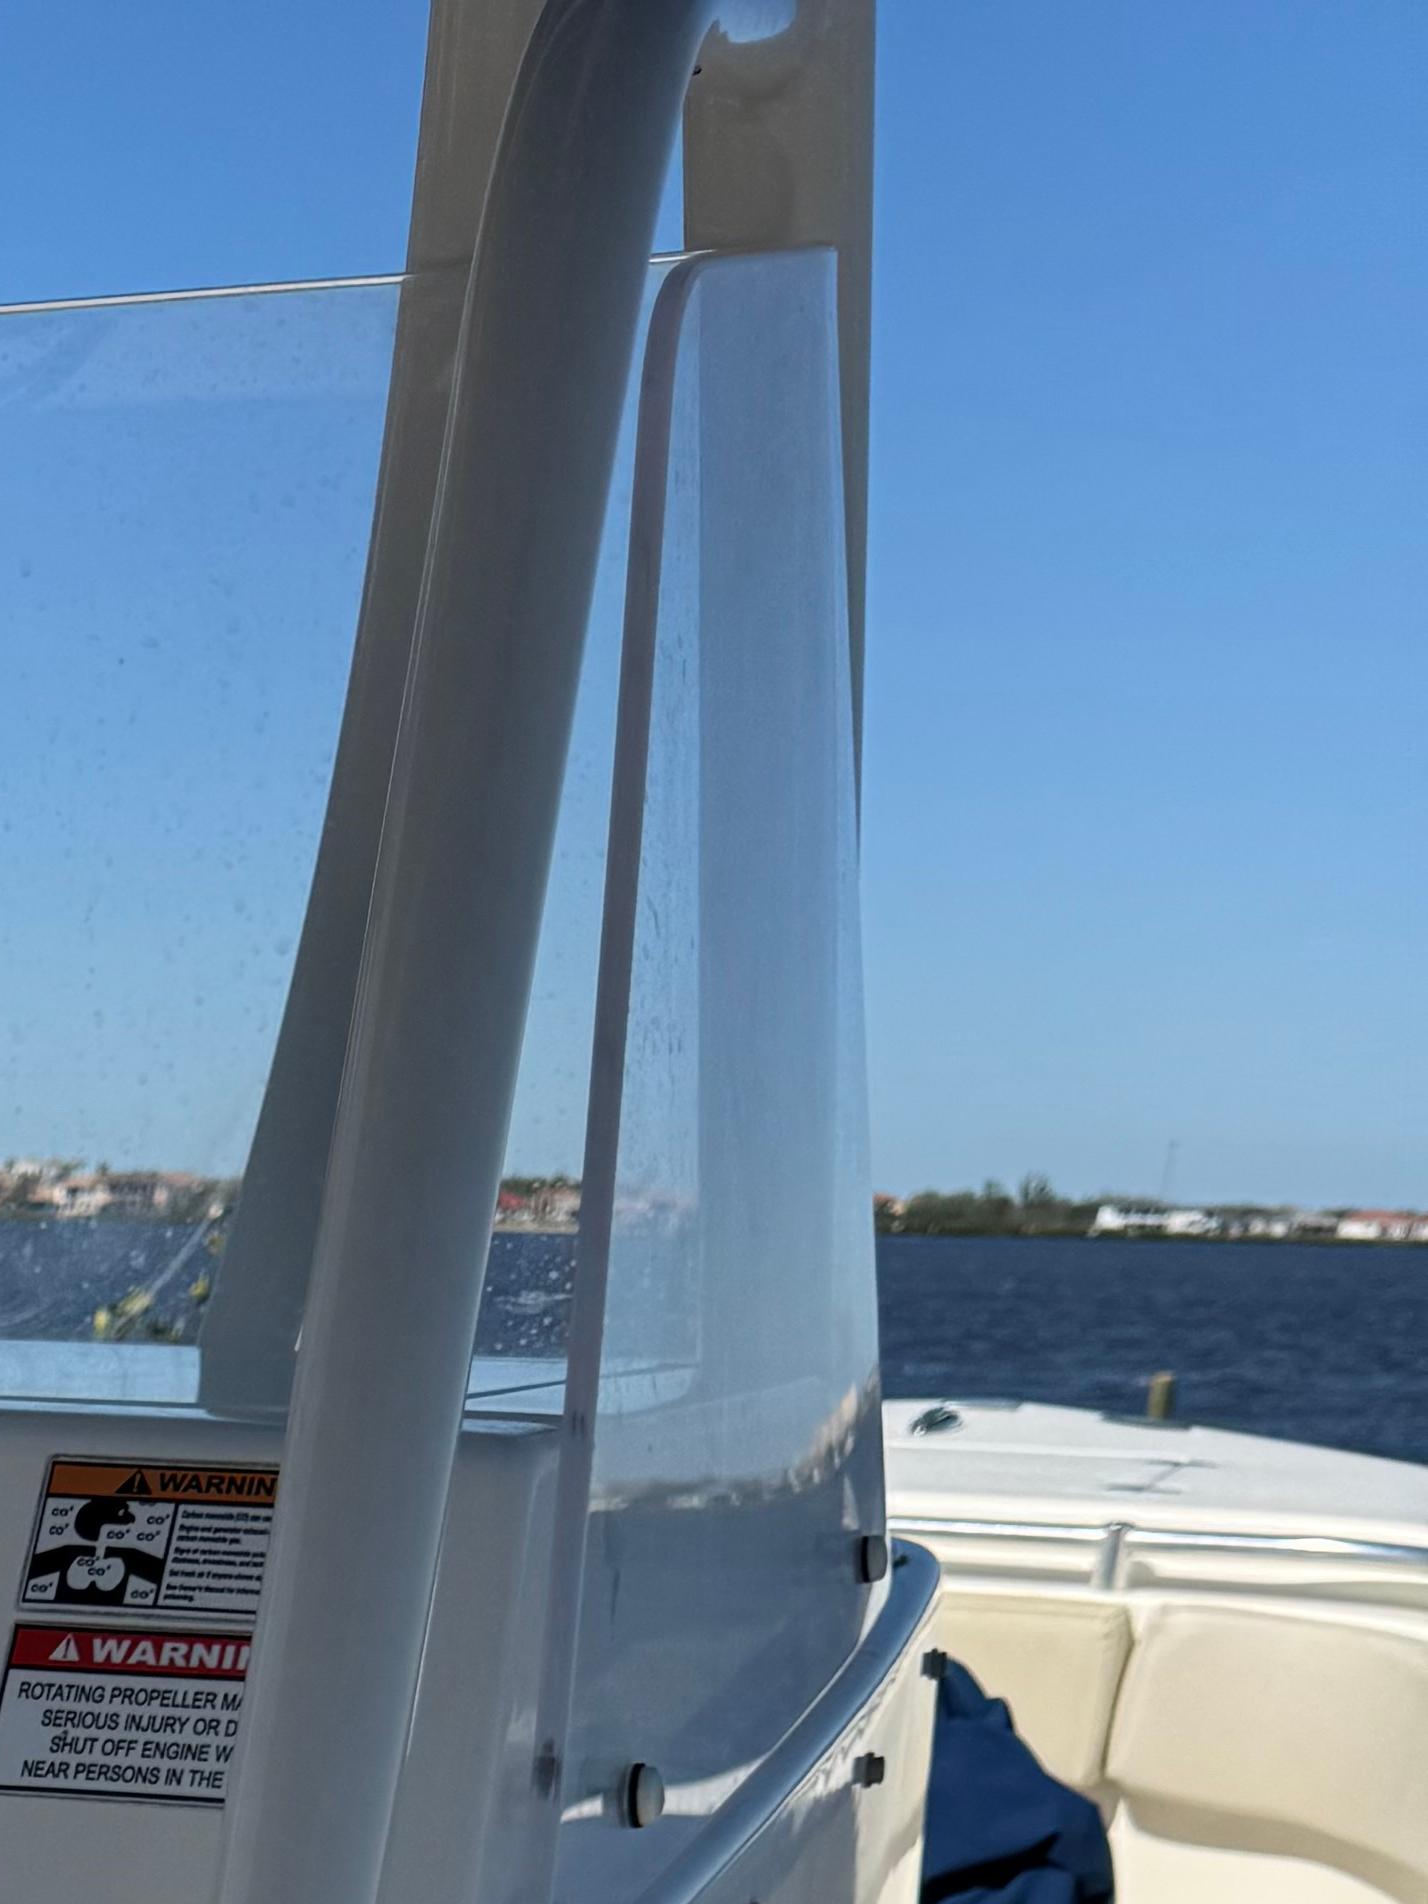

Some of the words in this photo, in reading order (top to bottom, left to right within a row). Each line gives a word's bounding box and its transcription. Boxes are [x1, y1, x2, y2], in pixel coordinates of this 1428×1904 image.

[158, 1472, 278, 1498] WARNIN
[17, 1681, 106, 1703] ROTATING
[109, 1686, 217, 1711] PROPELLER
[41, 1708, 120, 1731] SERIOUS
[124, 1714, 190, 1735] INJURY
[193, 1718, 221, 1737] OR
[49, 1736, 99, 1756] SHUT
[101, 1739, 139, 1758] OFF
[141, 1740, 212, 1762] ENGINE
[20, 1759, 71, 1779] NEAR
[73, 1762, 163, 1786] PERSONS
[164, 1768, 185, 1786] IN
[189, 1769, 224, 1789] THE
